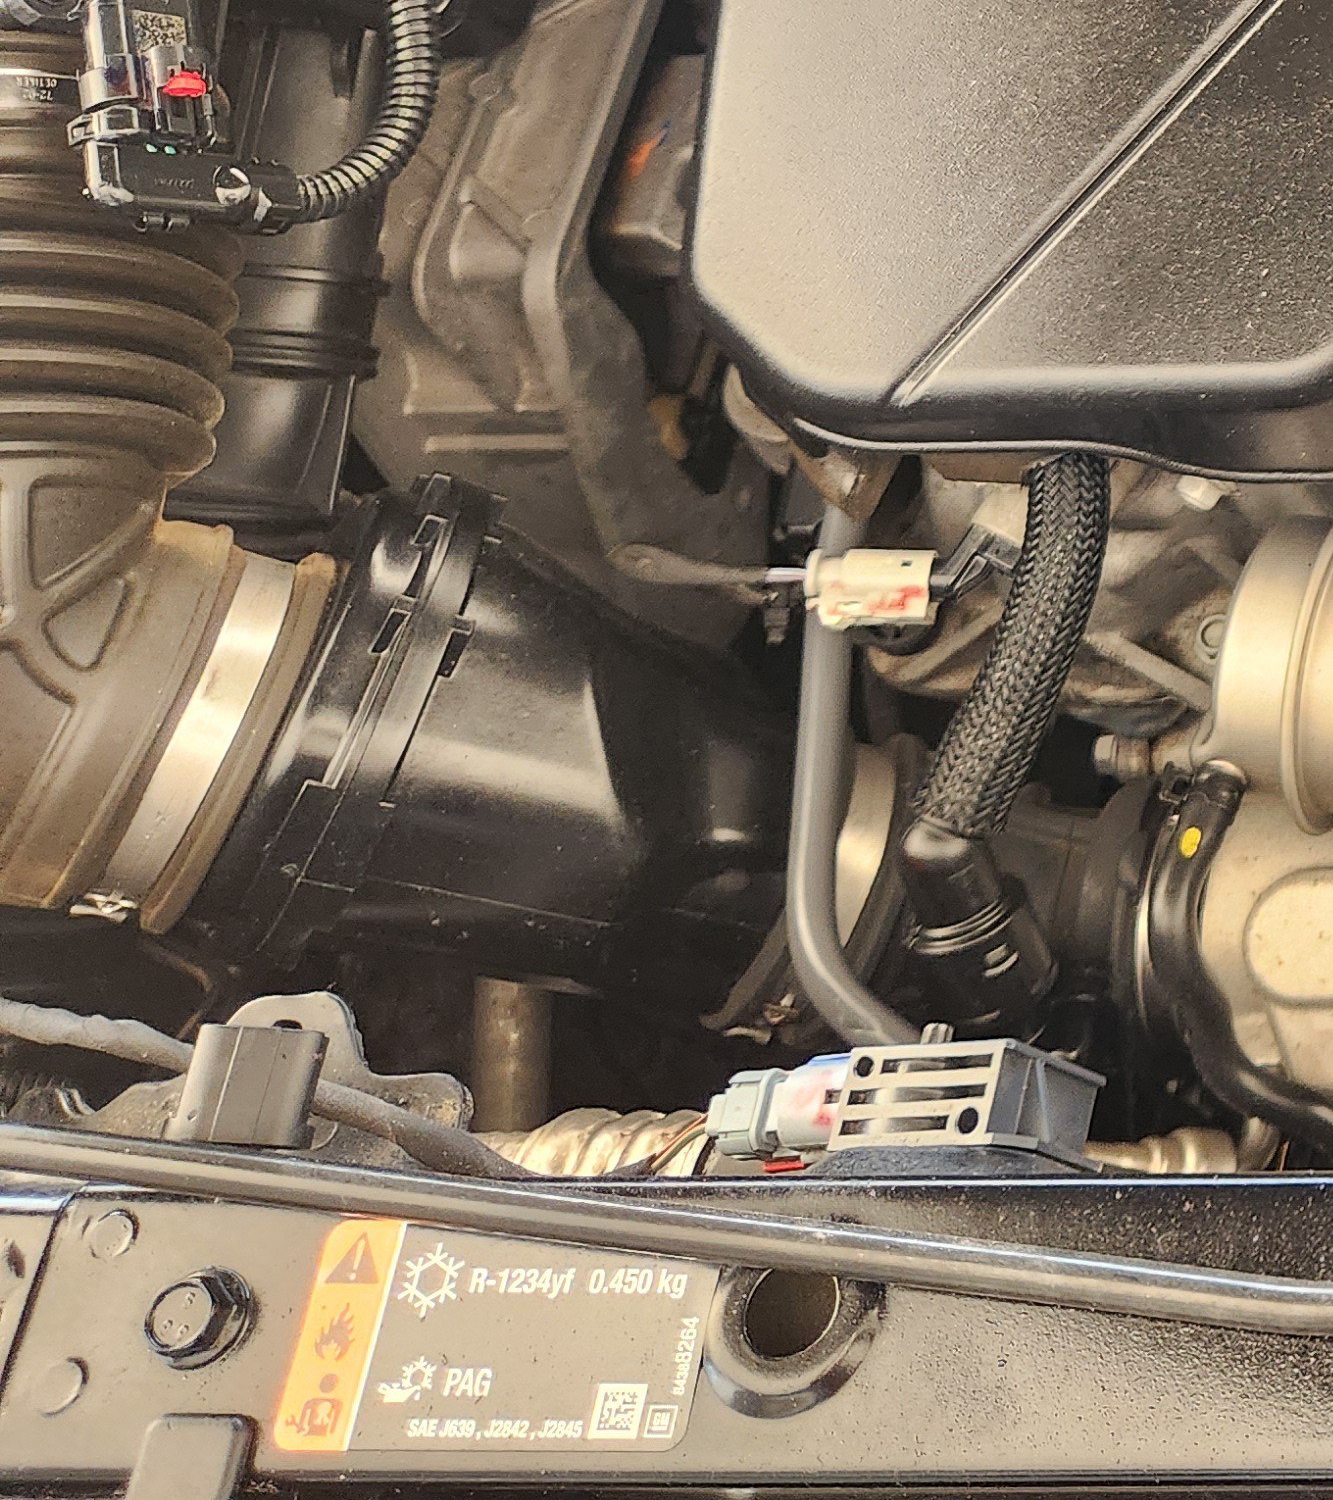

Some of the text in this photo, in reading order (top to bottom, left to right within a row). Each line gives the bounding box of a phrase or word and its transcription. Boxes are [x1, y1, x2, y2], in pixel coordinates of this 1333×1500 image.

[469, 1267, 688, 1299] R-1234yf 0.450 kg
[443, 1367, 492, 1398] PAG
[408, 1419, 437, 1438] SAE
[538, 1419, 583, 1438] J2845
[653, 1412, 671, 1425] GM
